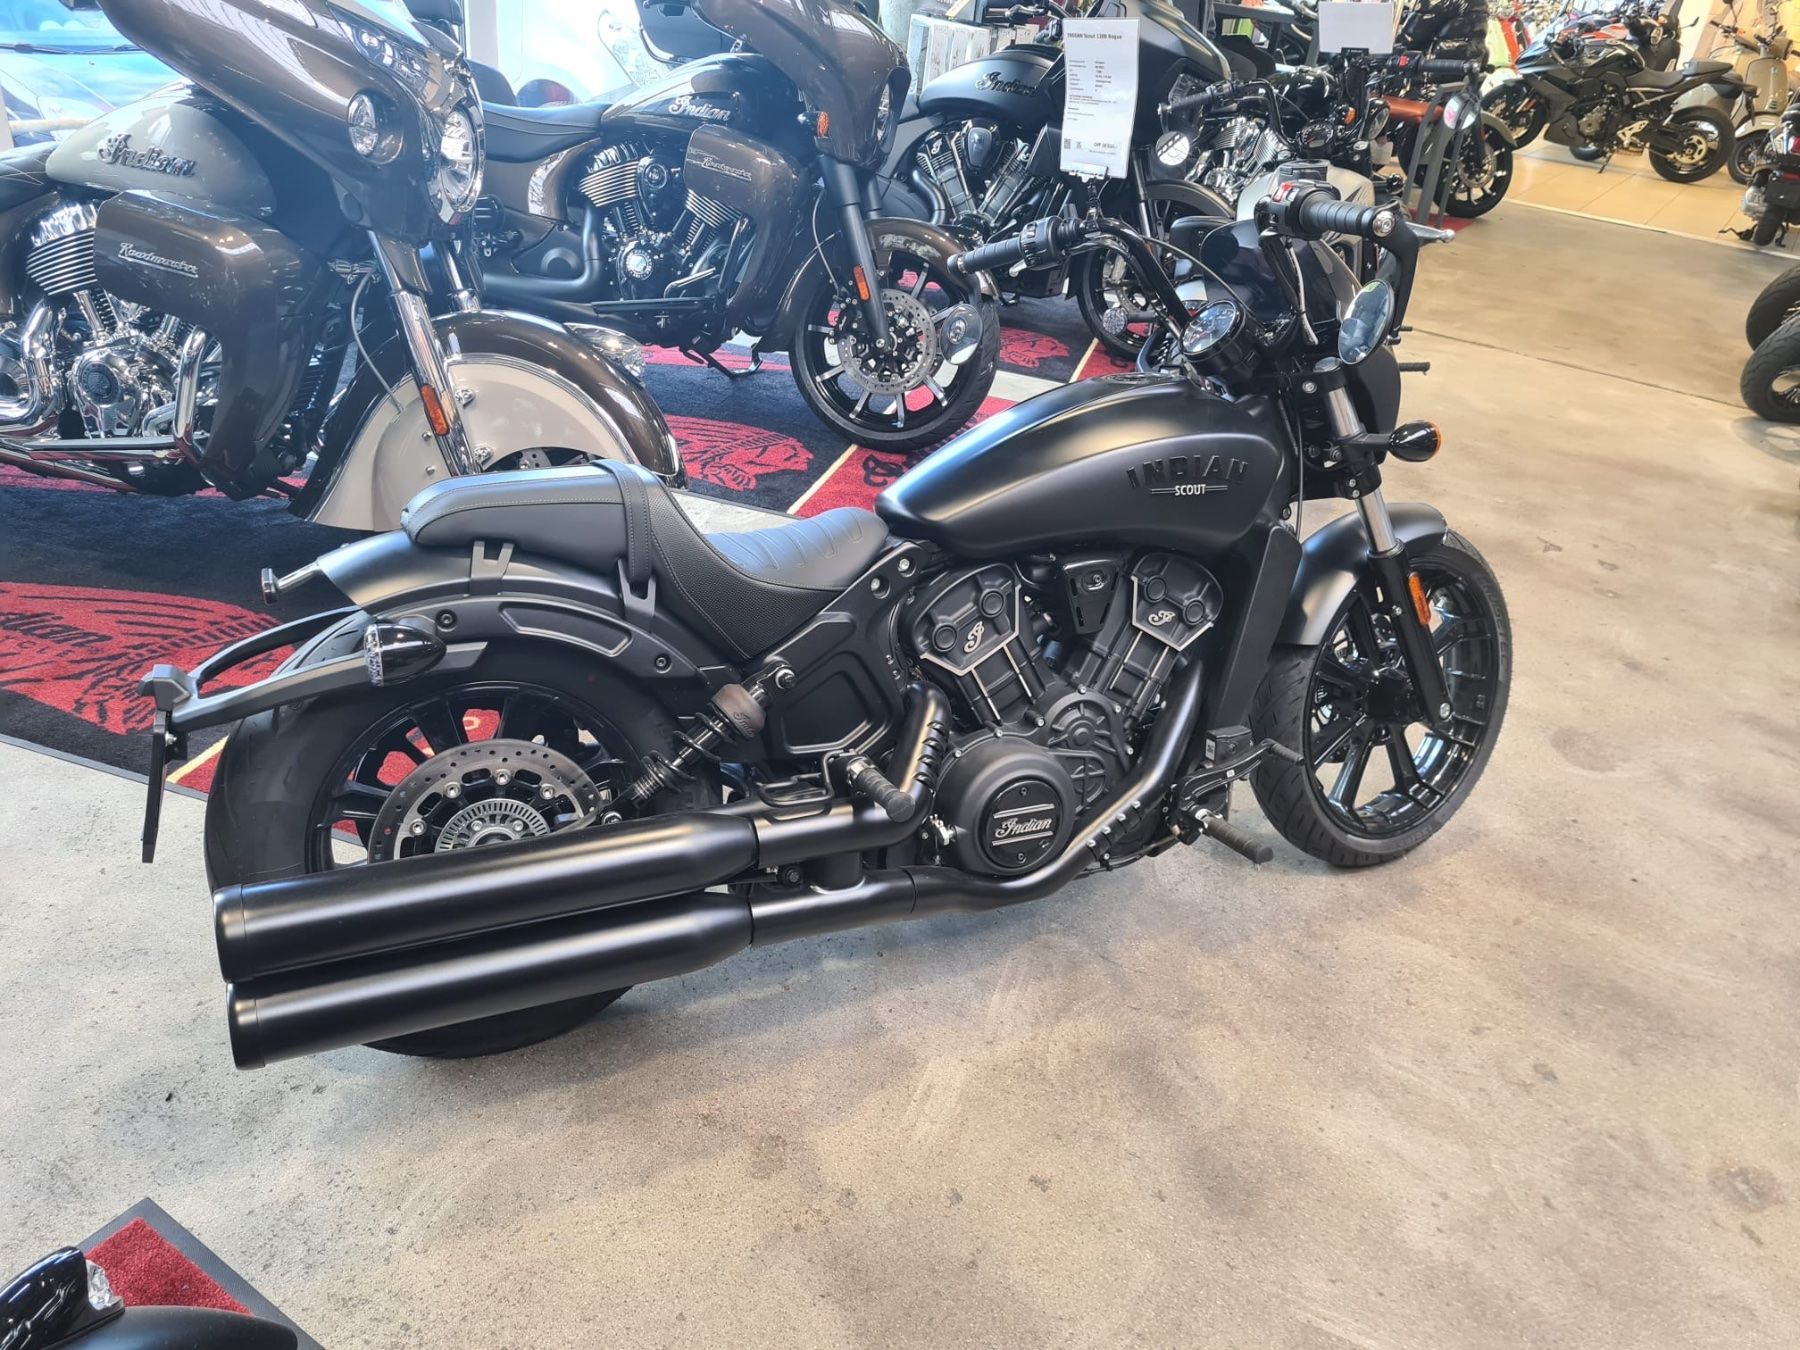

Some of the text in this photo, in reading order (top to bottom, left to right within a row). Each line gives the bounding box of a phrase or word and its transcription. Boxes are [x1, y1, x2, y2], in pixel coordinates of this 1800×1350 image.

[668, 95, 731, 121] Indian
[99, 132, 196, 177] Indian
[119, 242, 199, 275] Roadmaster
[1126, 454, 1248, 488] INDIAN
[1174, 484, 1206, 496] SCOUT
[995, 817, 1053, 839] Indian
